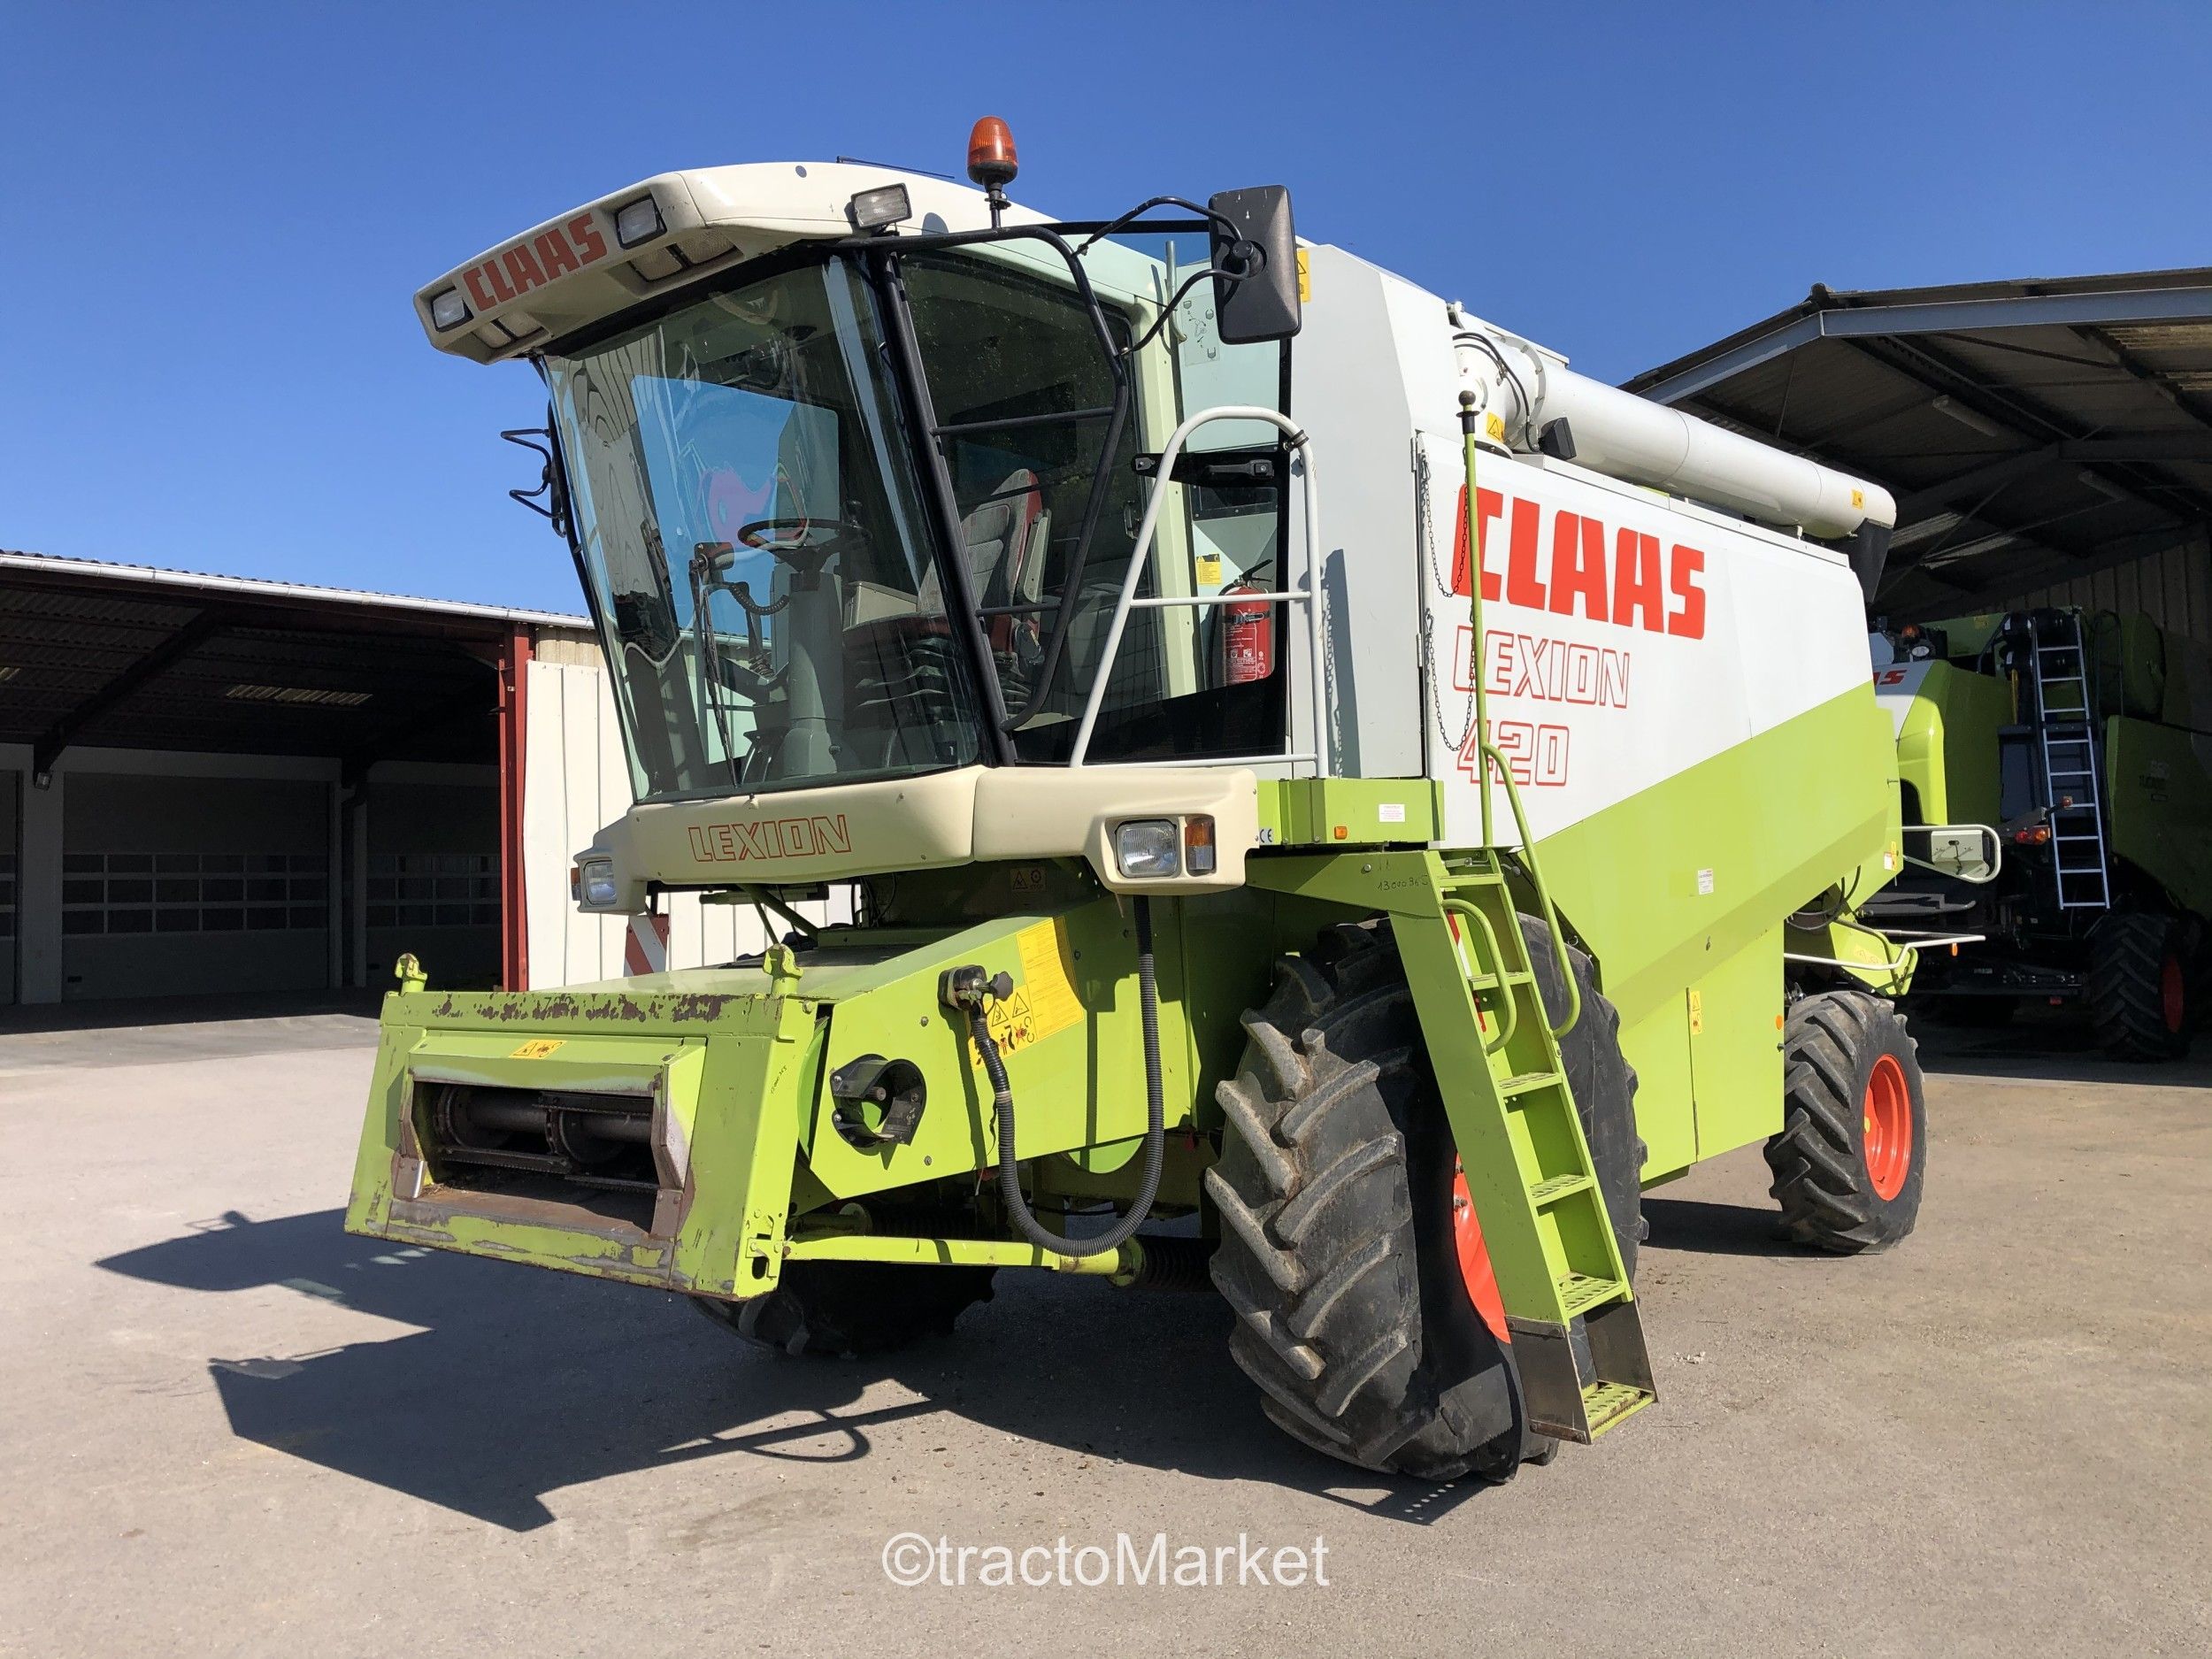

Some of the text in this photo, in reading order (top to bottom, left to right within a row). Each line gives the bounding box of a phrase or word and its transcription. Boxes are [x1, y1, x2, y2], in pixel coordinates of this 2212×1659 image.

[463, 212, 608, 311] CLAAS
[1451, 482, 1706, 640] CLAAS
[1453, 625, 1630, 709] LEXION
[1456, 718, 1570, 787] 420
[688, 814, 851, 863] LEXION
